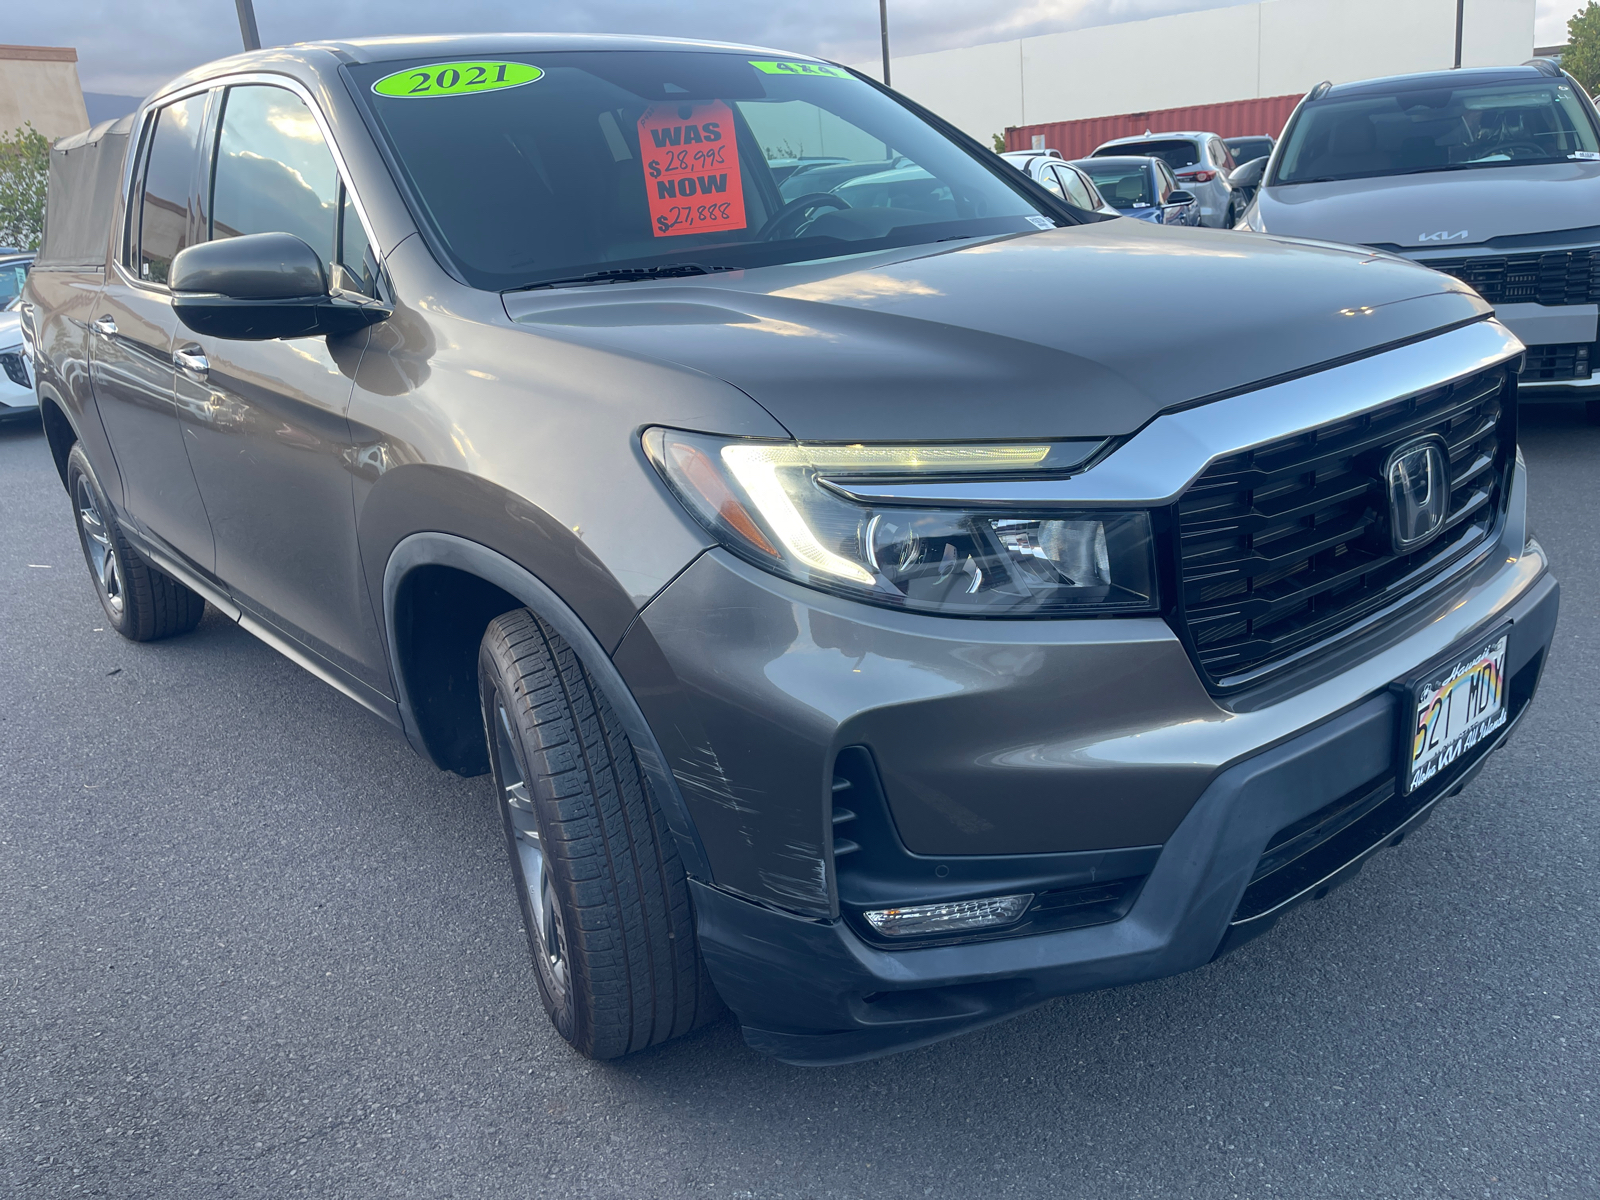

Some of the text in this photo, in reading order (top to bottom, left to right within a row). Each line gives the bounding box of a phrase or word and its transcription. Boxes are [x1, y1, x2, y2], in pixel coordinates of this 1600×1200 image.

[407, 64, 510, 94] 2021
[650, 122, 722, 149] WAS
[656, 173, 728, 200] NOW
[656, 202, 731, 234] $27,888
[1414, 653, 1505, 761] 521 MDY
[1409, 761, 1437, 792] Aloha
